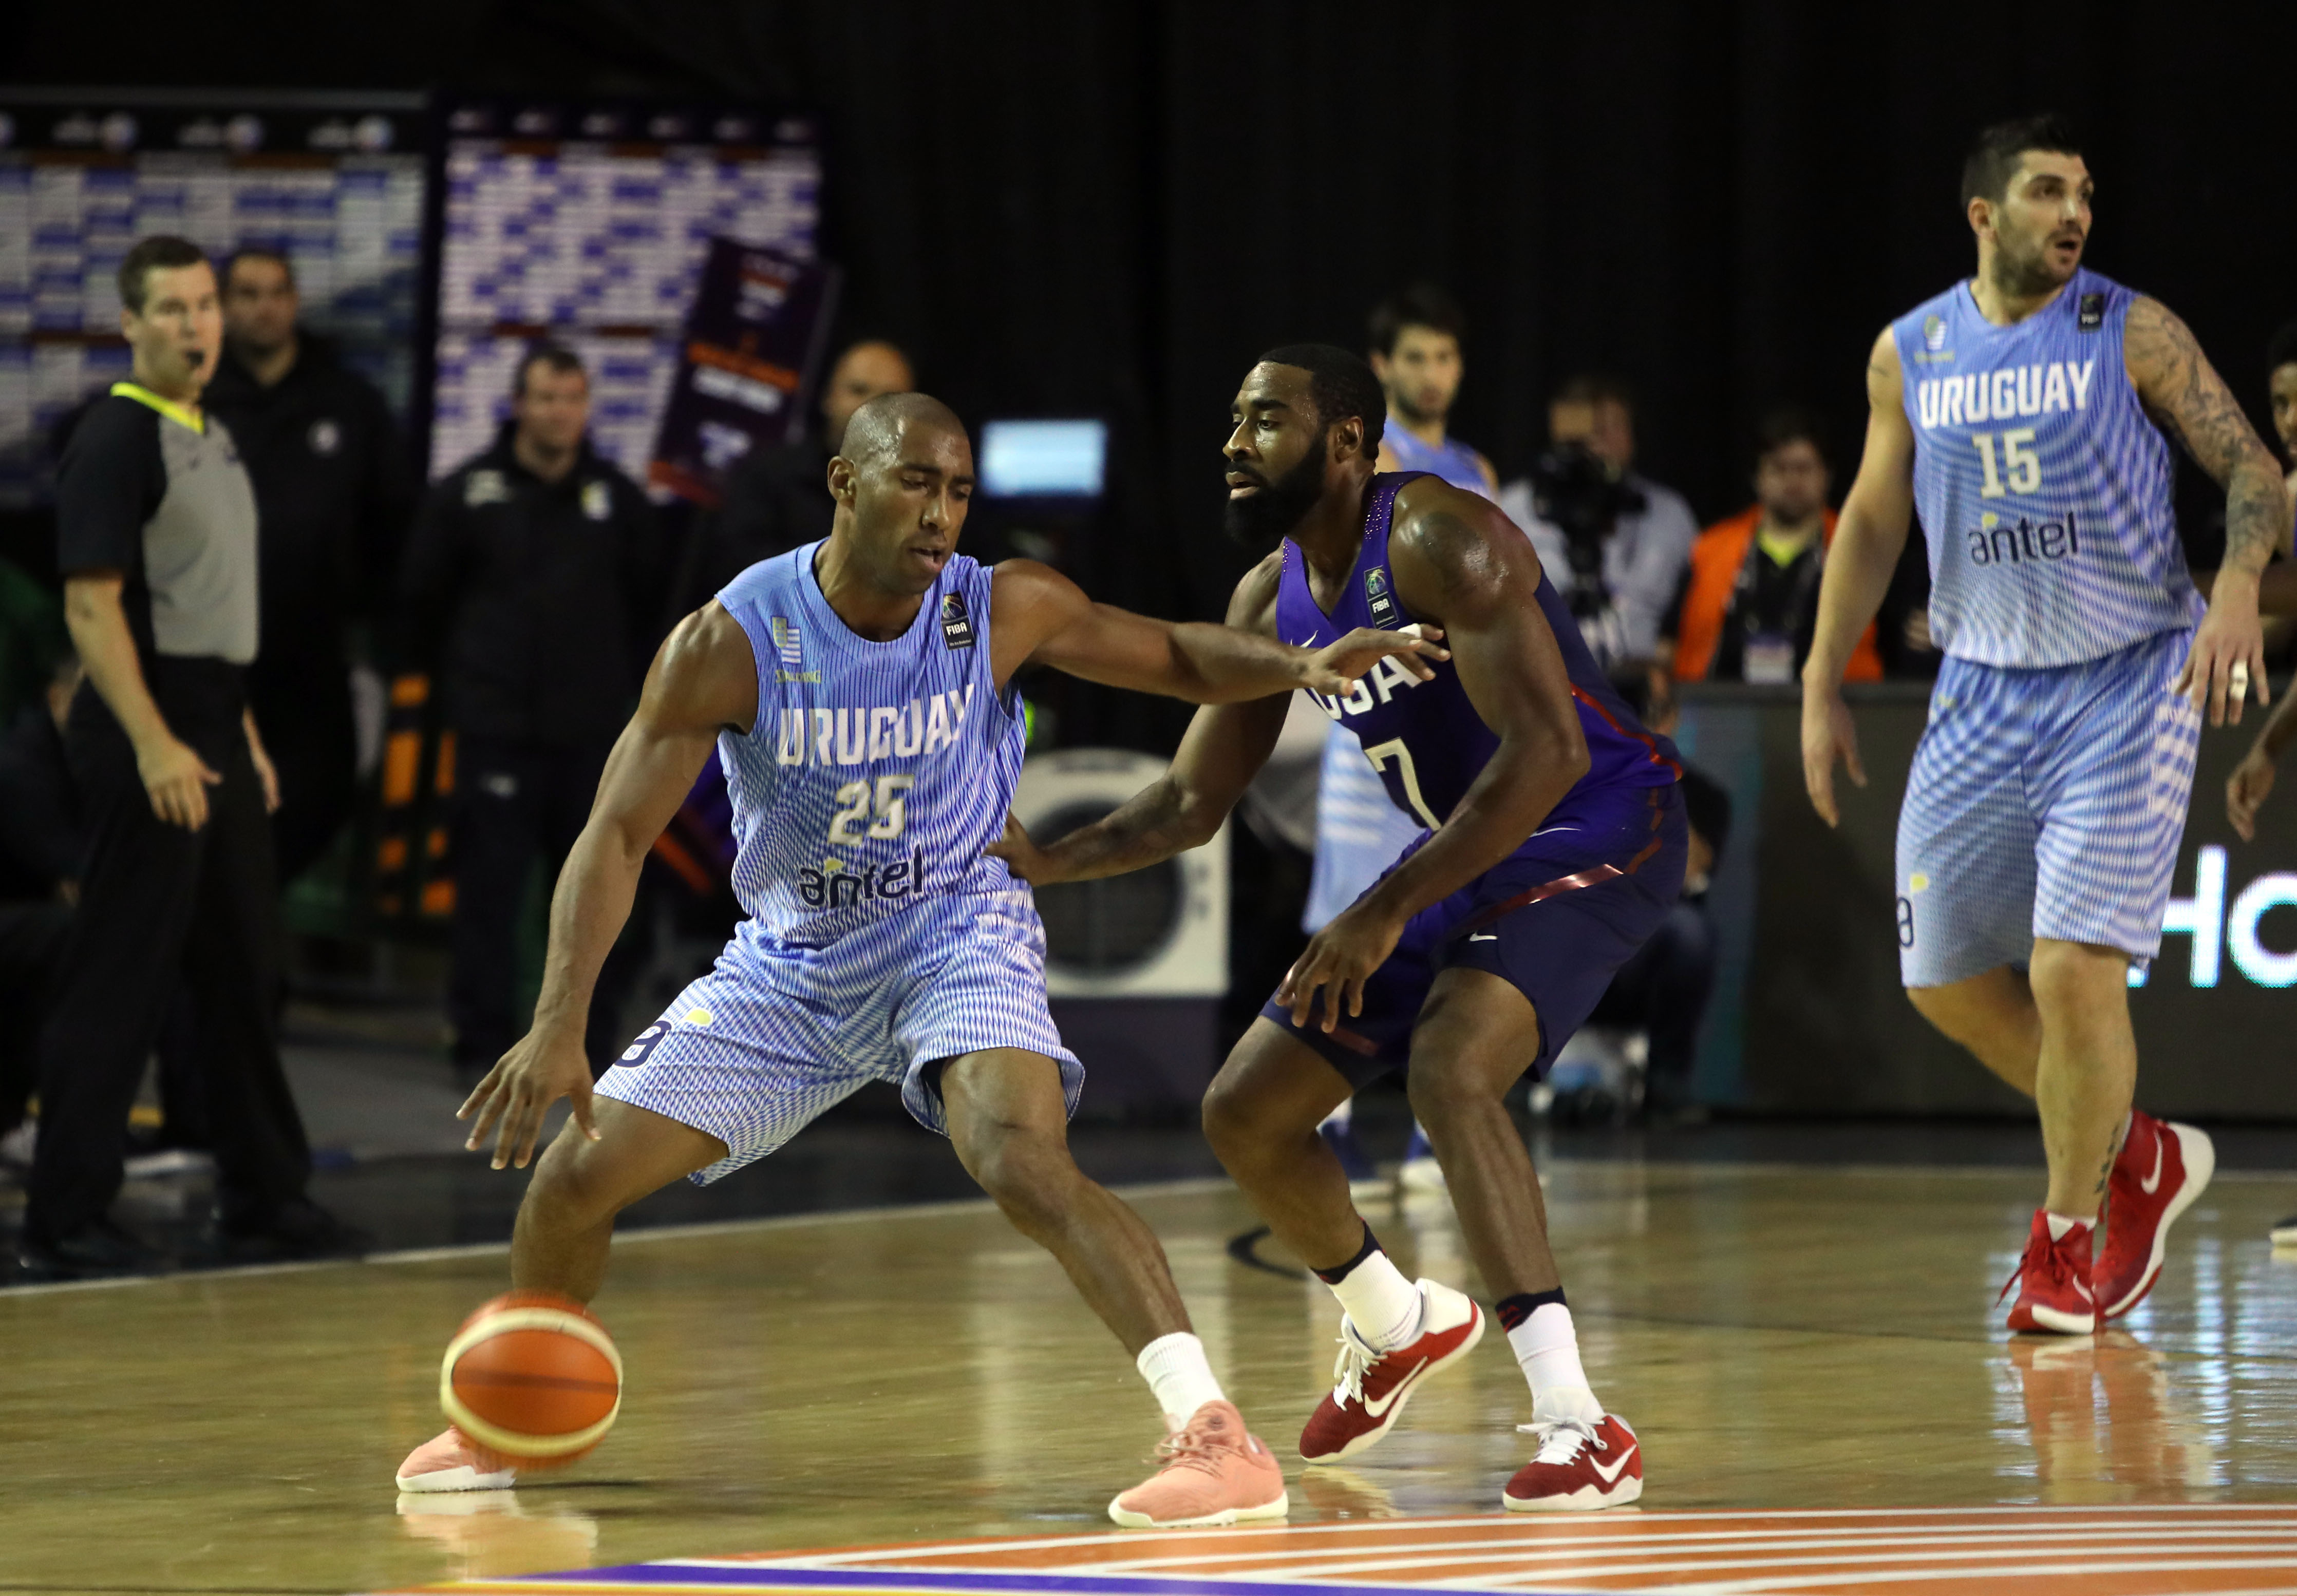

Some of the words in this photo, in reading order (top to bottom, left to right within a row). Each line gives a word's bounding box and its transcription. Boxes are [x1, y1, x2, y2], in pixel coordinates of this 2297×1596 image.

[1918, 360, 2094, 429] URUGUAY
[1971, 428, 2042, 499] 15
[1968, 512, 2078, 566] antel
[946, 622, 968, 636] FIBA
[1372, 598, 1390, 614] FIBA
[775, 669, 821, 684] SALDING
[778, 684, 974, 767] URUGUAY
[827, 774, 914, 846] 25
[1363, 736, 1441, 832] 7
[799, 844, 924, 908] antel
